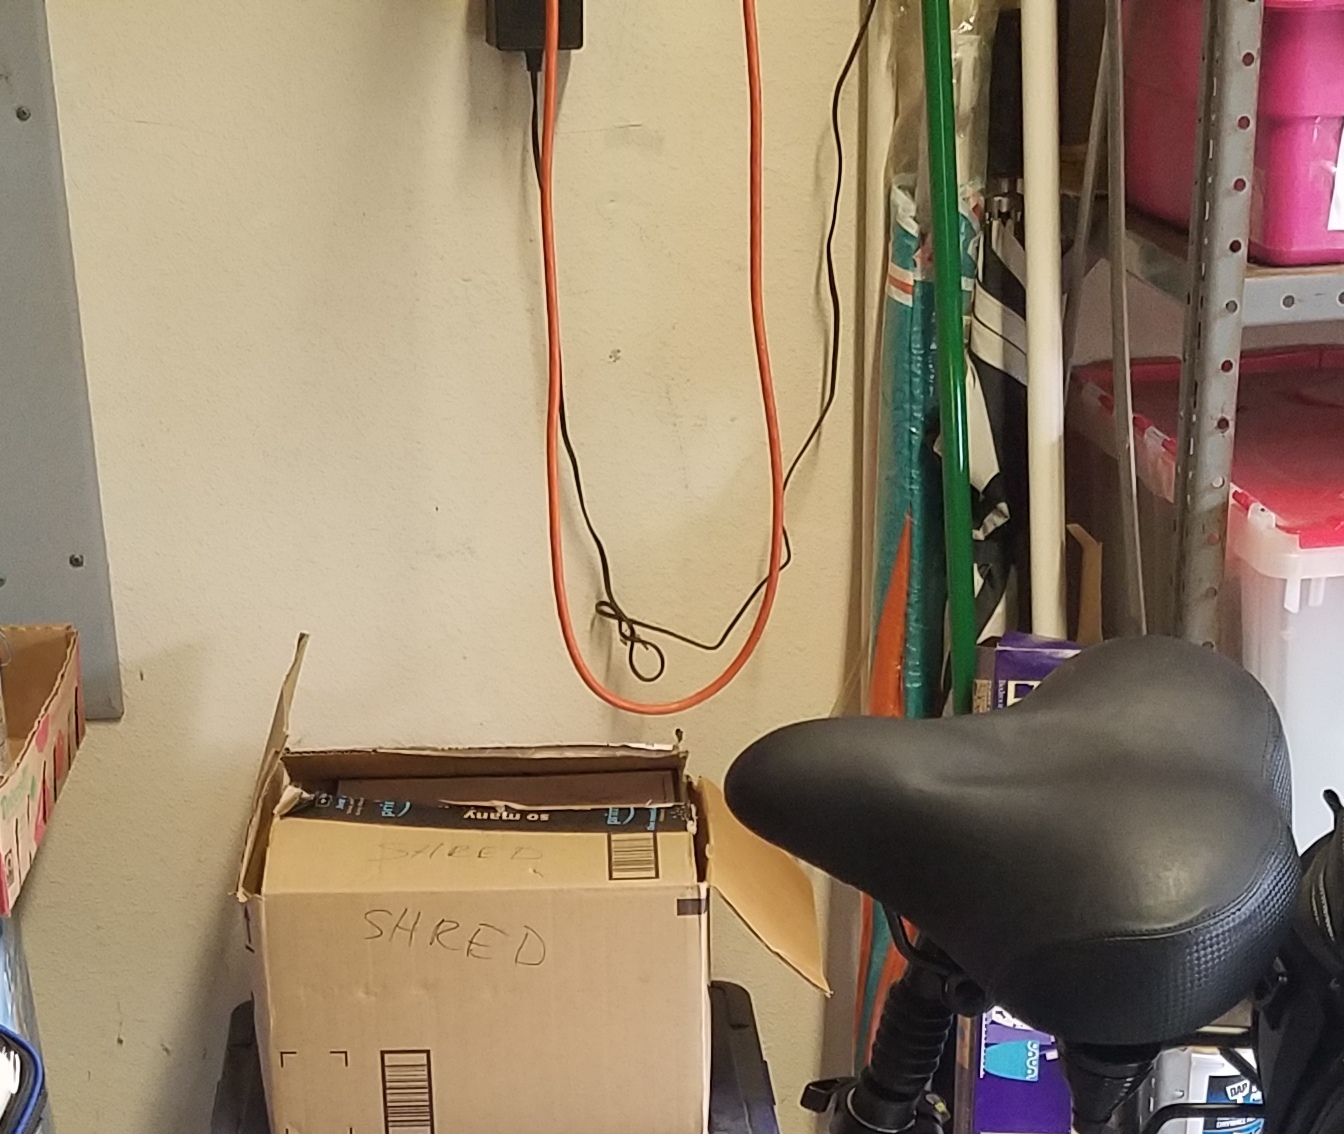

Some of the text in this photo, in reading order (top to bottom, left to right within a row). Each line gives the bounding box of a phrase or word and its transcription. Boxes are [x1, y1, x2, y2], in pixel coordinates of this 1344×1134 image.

[463, 809, 550, 821] so many
[378, 842, 543, 862] SHRED
[364, 907, 546, 967] SHRED
[1229, 1080, 1249, 1098] DAP
